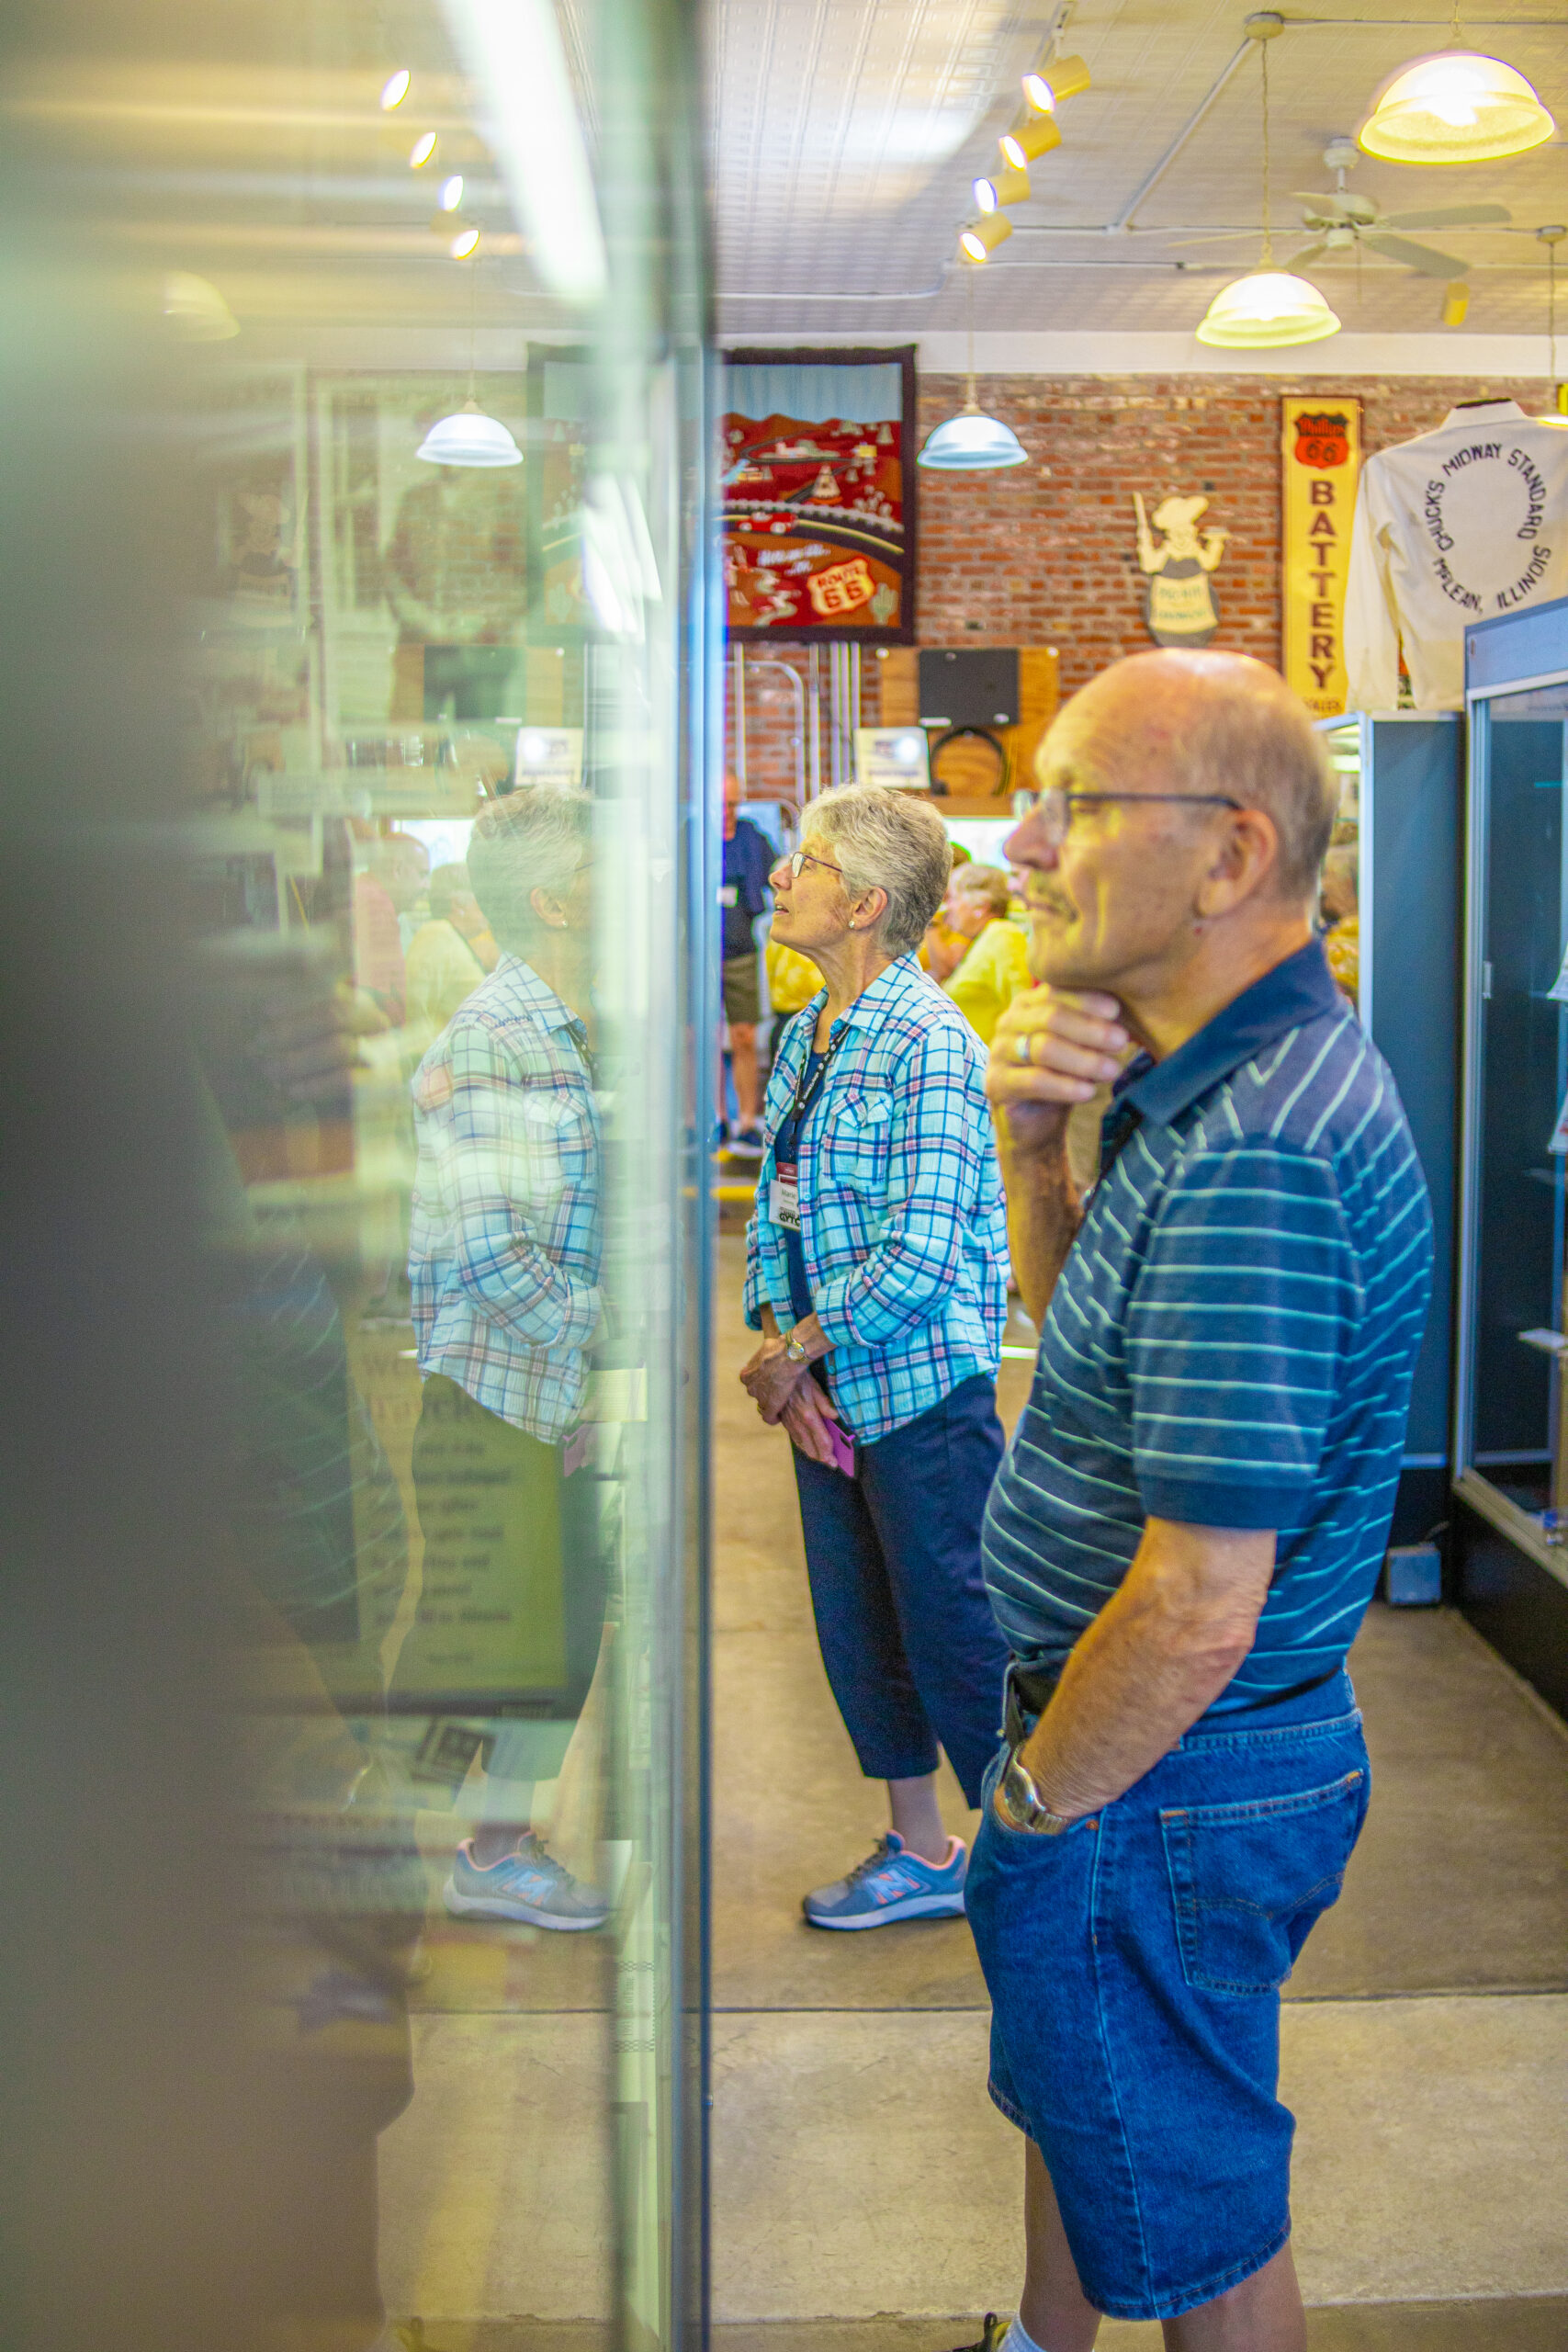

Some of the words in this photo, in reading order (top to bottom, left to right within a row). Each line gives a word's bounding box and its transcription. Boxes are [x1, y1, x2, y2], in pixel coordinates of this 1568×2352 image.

[1306, 439, 1338, 462] 66
[1425, 480, 1454, 551] CHUCK'S
[1442, 443, 1502, 476] MIDWAY
[1507, 447, 1546, 539] STANDARD
[824, 581, 863, 608] 66
[1308, 479, 1337, 690] BATTERY
[1496, 545, 1551, 610] ILLINOIS
